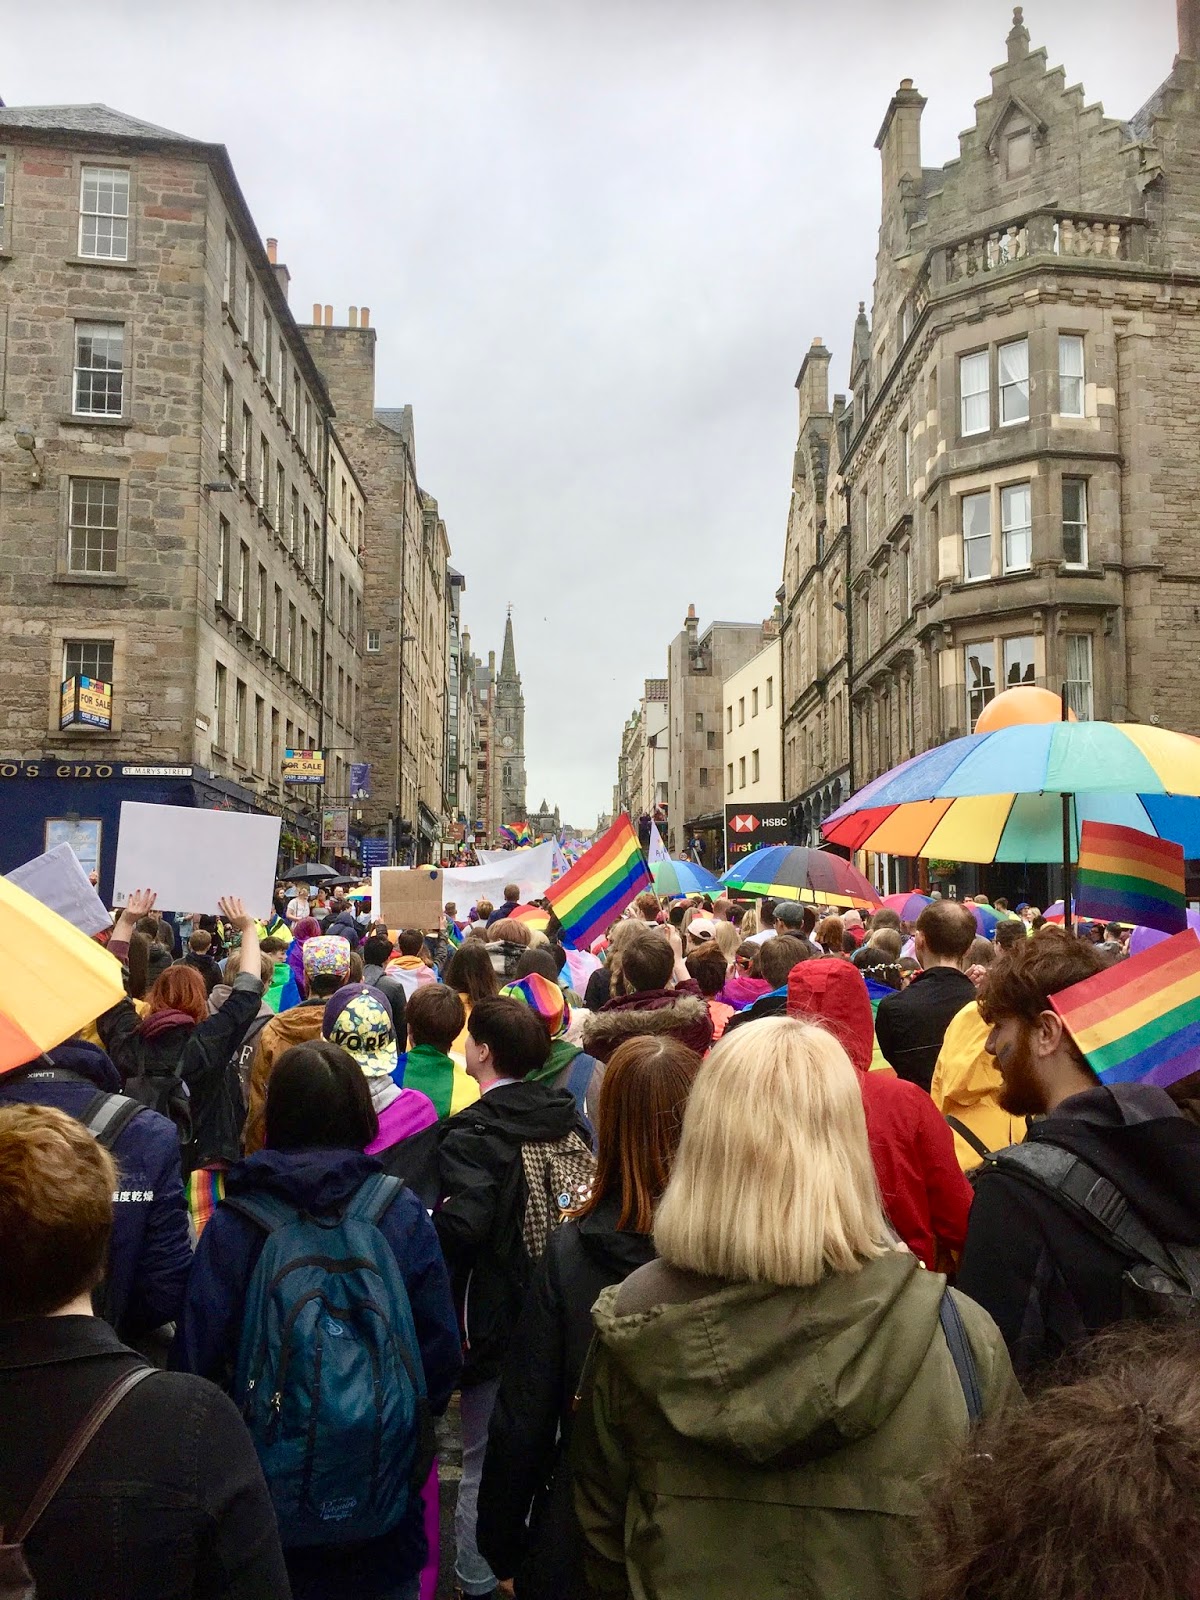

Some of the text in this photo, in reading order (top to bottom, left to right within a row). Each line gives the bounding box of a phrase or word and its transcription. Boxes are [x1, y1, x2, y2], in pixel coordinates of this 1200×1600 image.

[81, 694, 93, 705] FOR
[95, 698, 111, 710] SALE
[302, 762, 322, 770] SALE
[761, 818, 788, 827] HSBC
[729, 842, 752, 852] first
